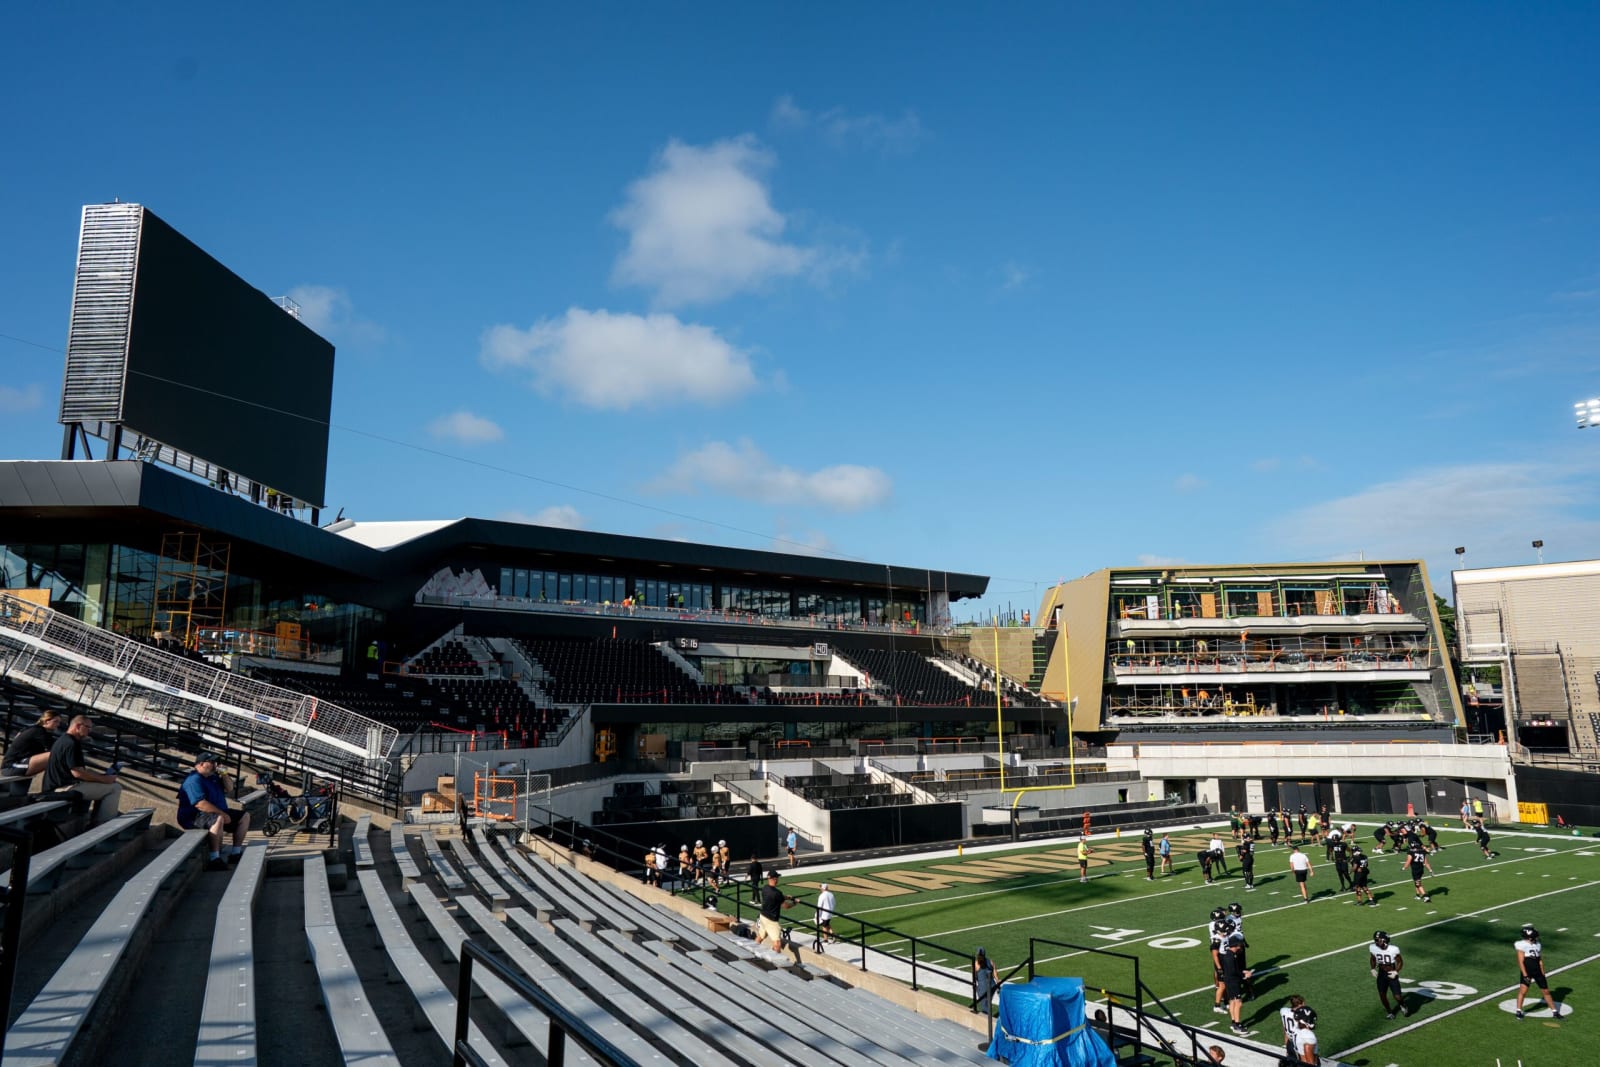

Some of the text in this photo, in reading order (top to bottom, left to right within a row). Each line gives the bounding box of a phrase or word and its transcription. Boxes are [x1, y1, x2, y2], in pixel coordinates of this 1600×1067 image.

[680, 638, 698, 648] 5:16
[817, 645, 826, 654] 40
[1414, 853, 1424, 862] 73
[1376, 953, 1391, 964] 20
[1282, 1014, 1295, 1033] 10
